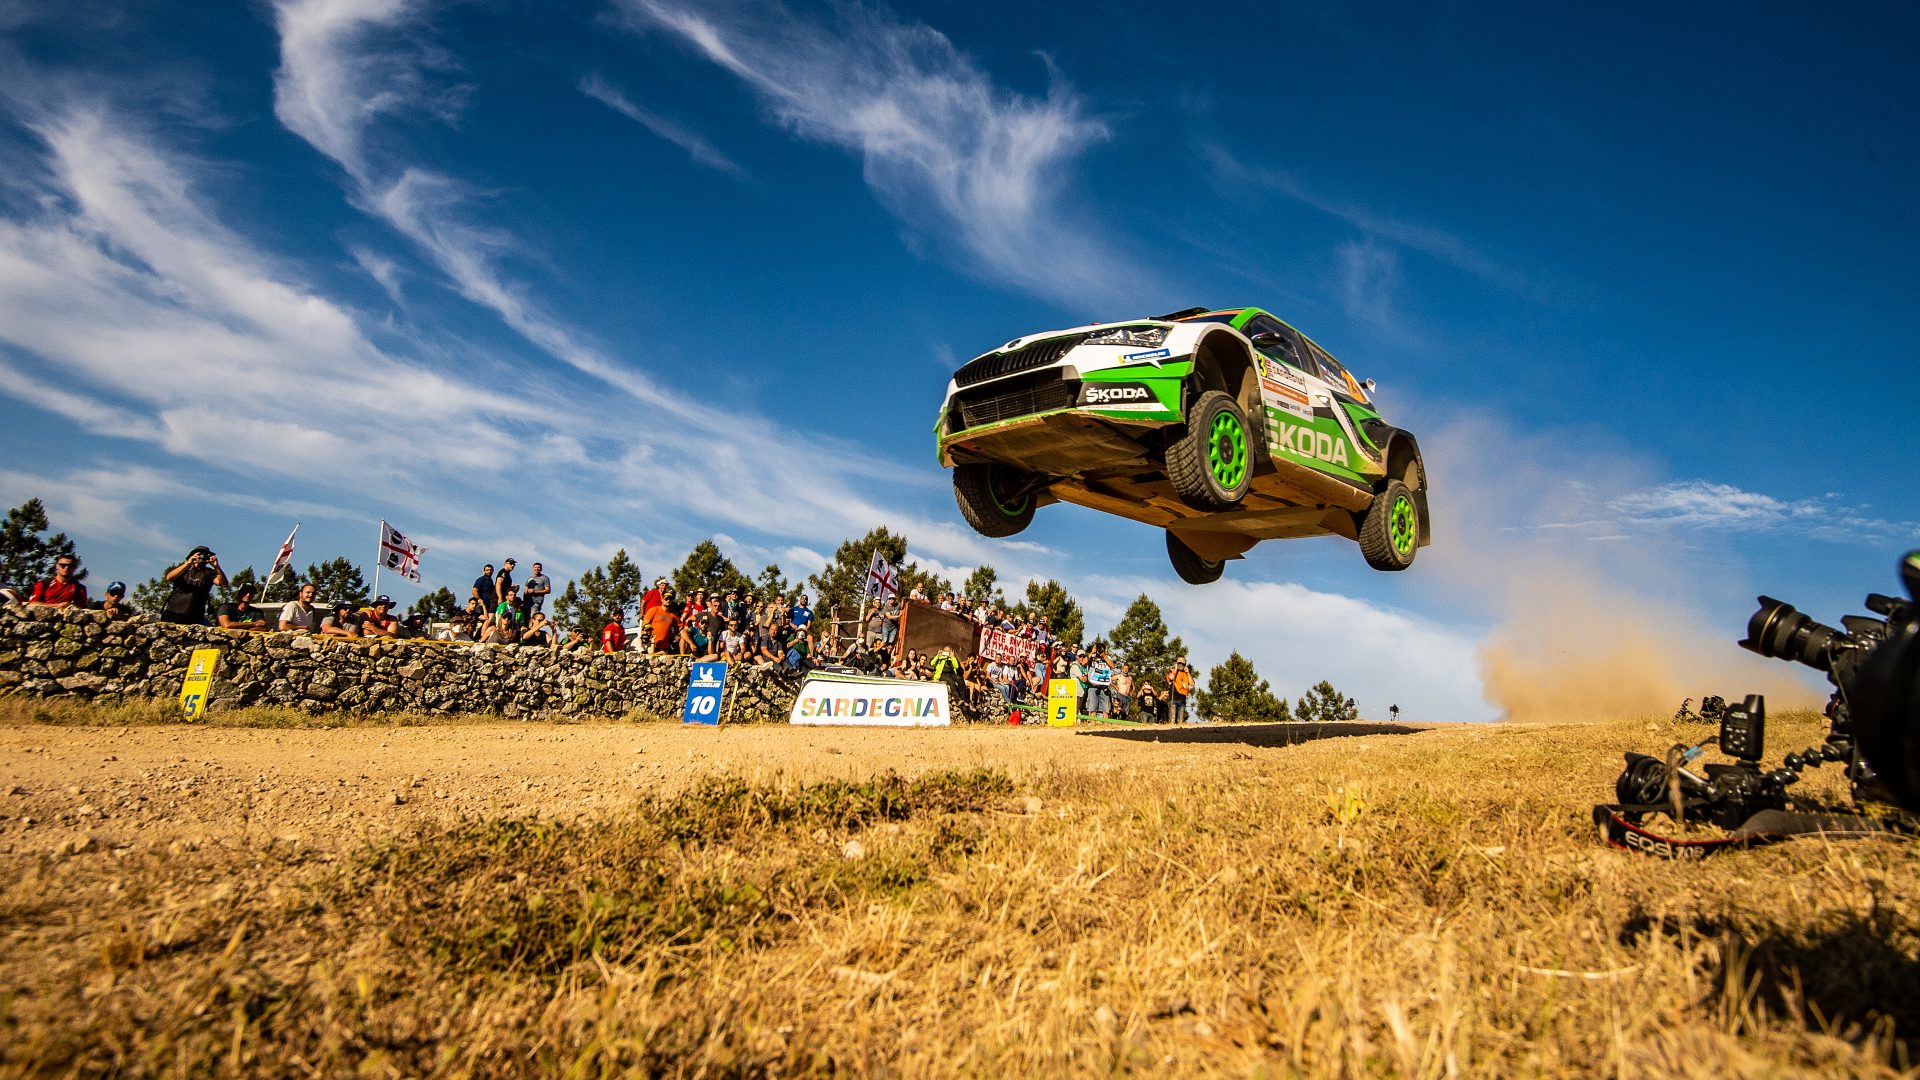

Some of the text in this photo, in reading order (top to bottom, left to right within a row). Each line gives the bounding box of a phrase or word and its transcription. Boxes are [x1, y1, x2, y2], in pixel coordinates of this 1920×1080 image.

[1086, 387, 1149, 402] ŠKODA
[184, 694, 201, 716] 15
[690, 695, 716, 715] 10
[801, 697, 940, 717] SARDEGNA
[1055, 706, 1068, 720] 5
[1625, 830, 1669, 857] EOS
